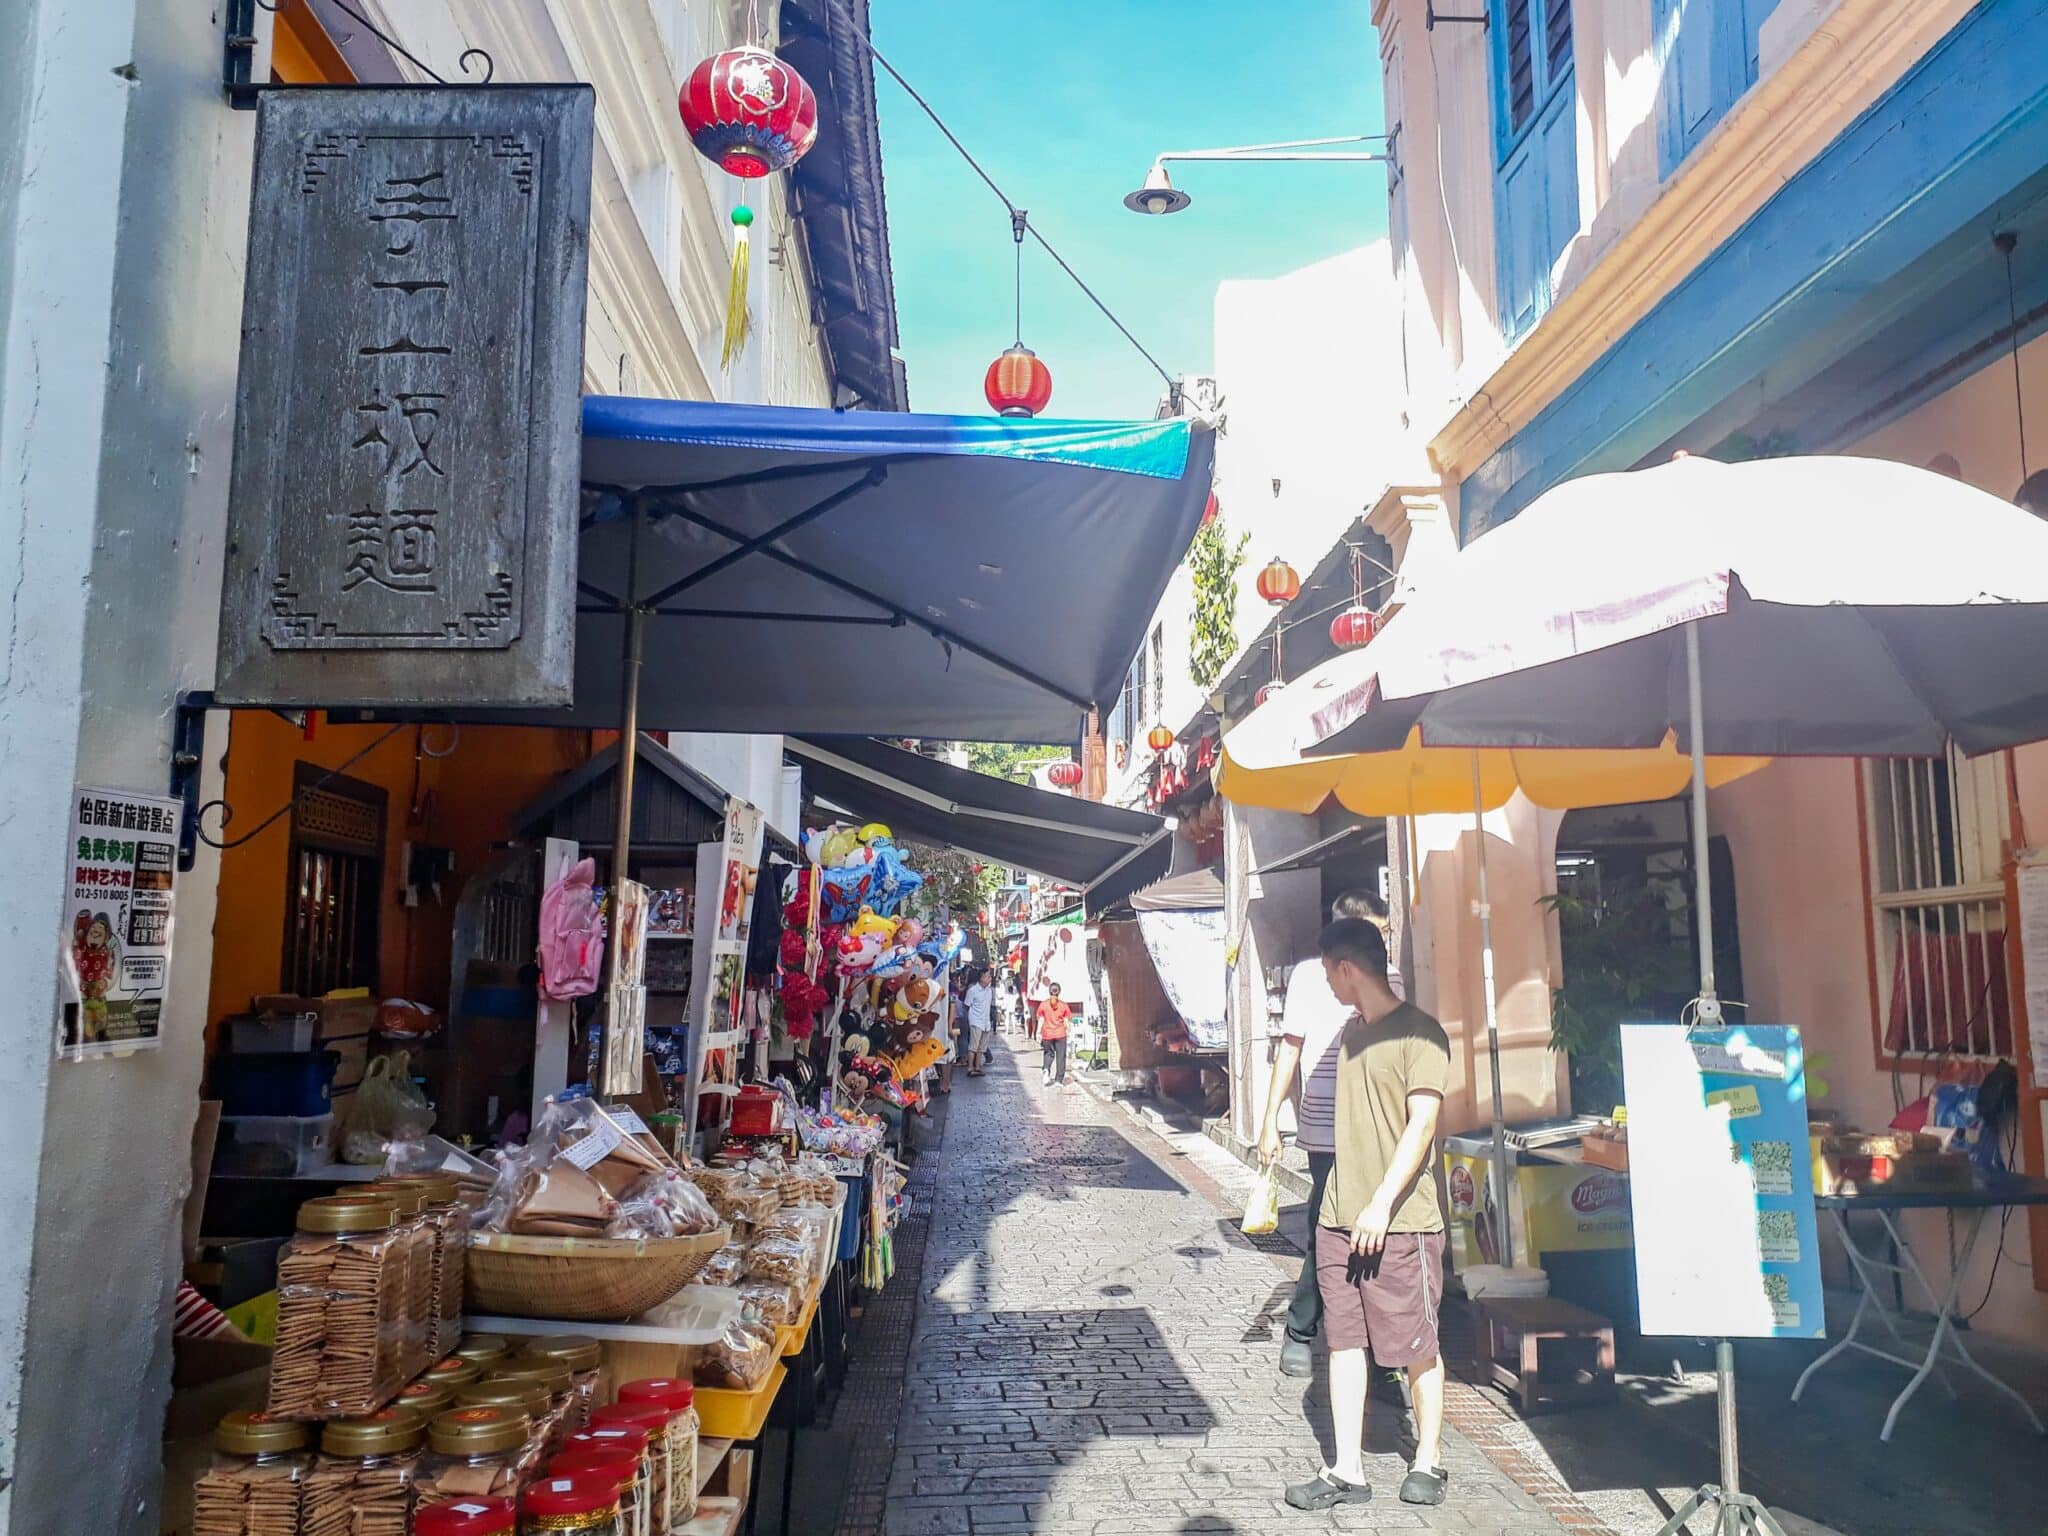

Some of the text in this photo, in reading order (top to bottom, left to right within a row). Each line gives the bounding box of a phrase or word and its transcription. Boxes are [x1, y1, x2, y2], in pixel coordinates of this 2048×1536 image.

[80, 798, 173, 833] 怡保新旅游景点
[77, 837, 134, 864] 免费参观
[75, 866, 132, 887] 财神艺术馆
[75, 888, 108, 899] 012-510
